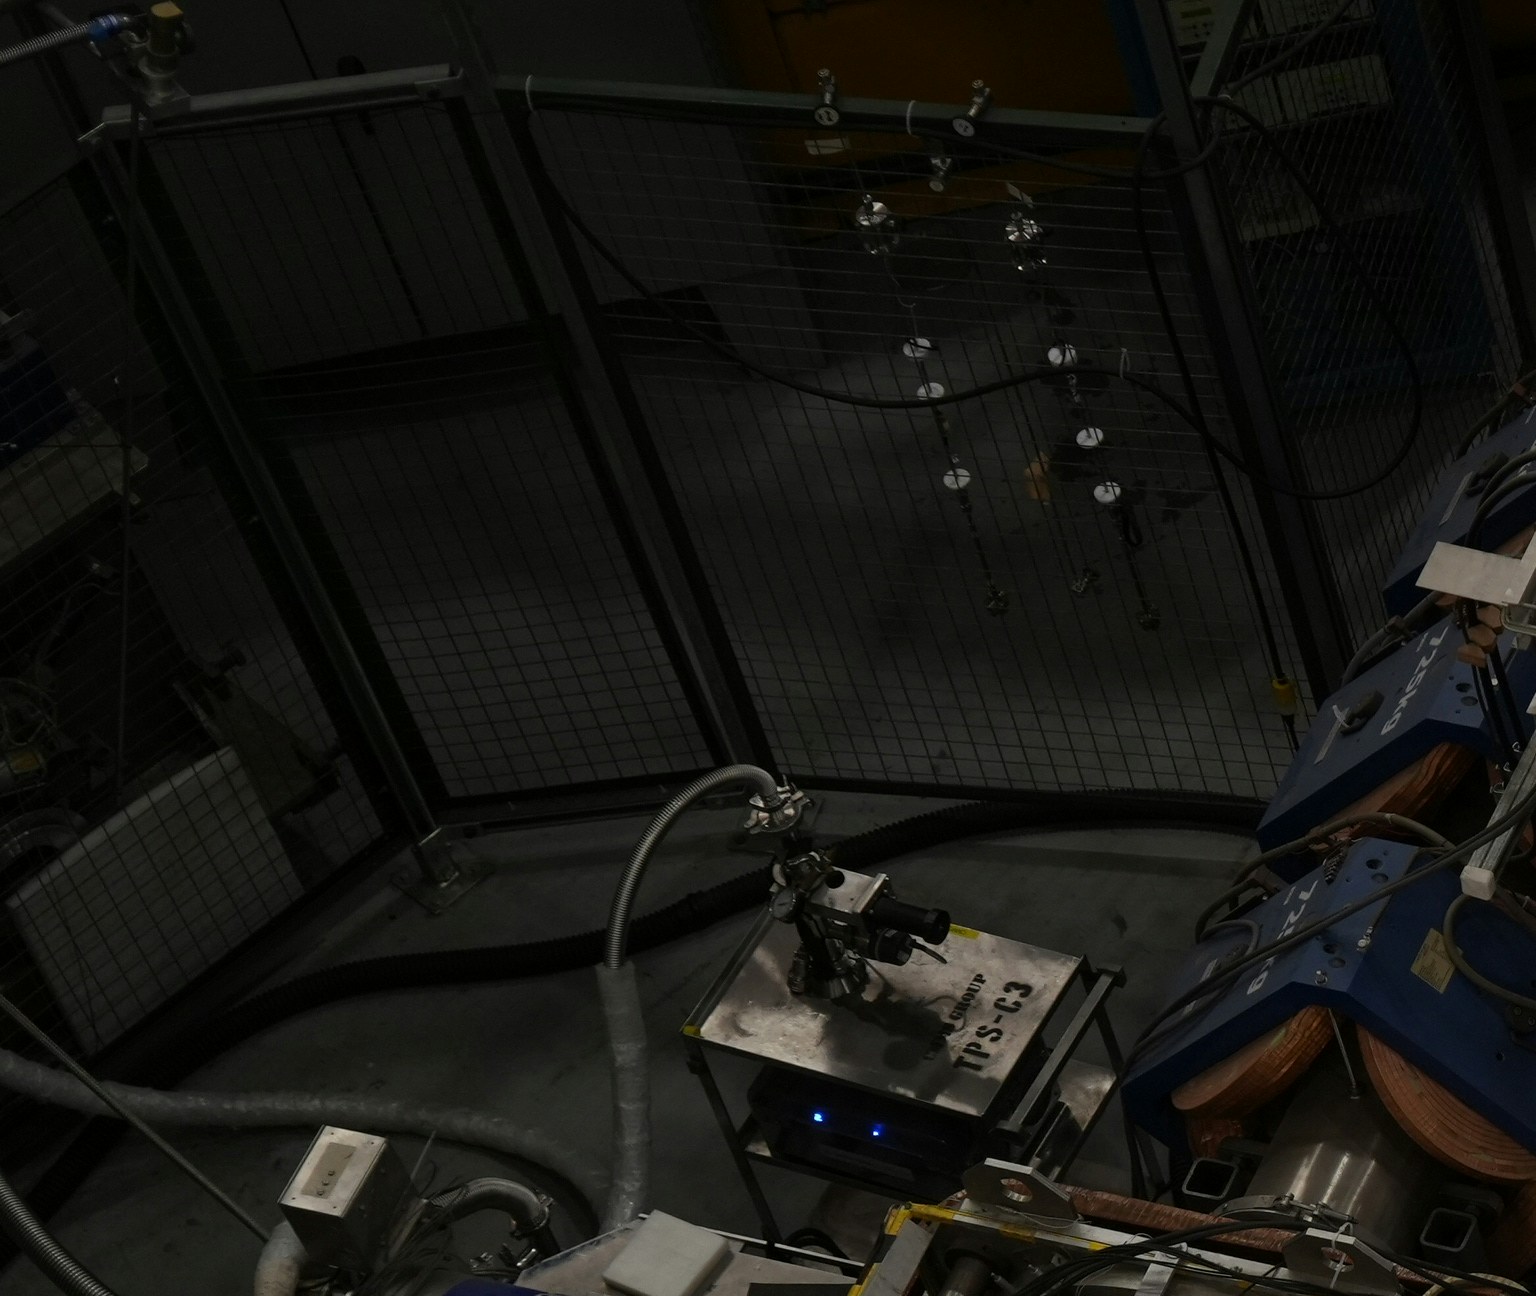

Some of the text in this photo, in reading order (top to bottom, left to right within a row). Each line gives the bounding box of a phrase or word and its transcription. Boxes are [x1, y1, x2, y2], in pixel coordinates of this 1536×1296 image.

[1380, 626, 1450, 736] 725kg
[1246, 880, 1319, 995] 72g
[949, 973, 987, 1021] GROUP
[953, 981, 1033, 1072] TPS-C3
